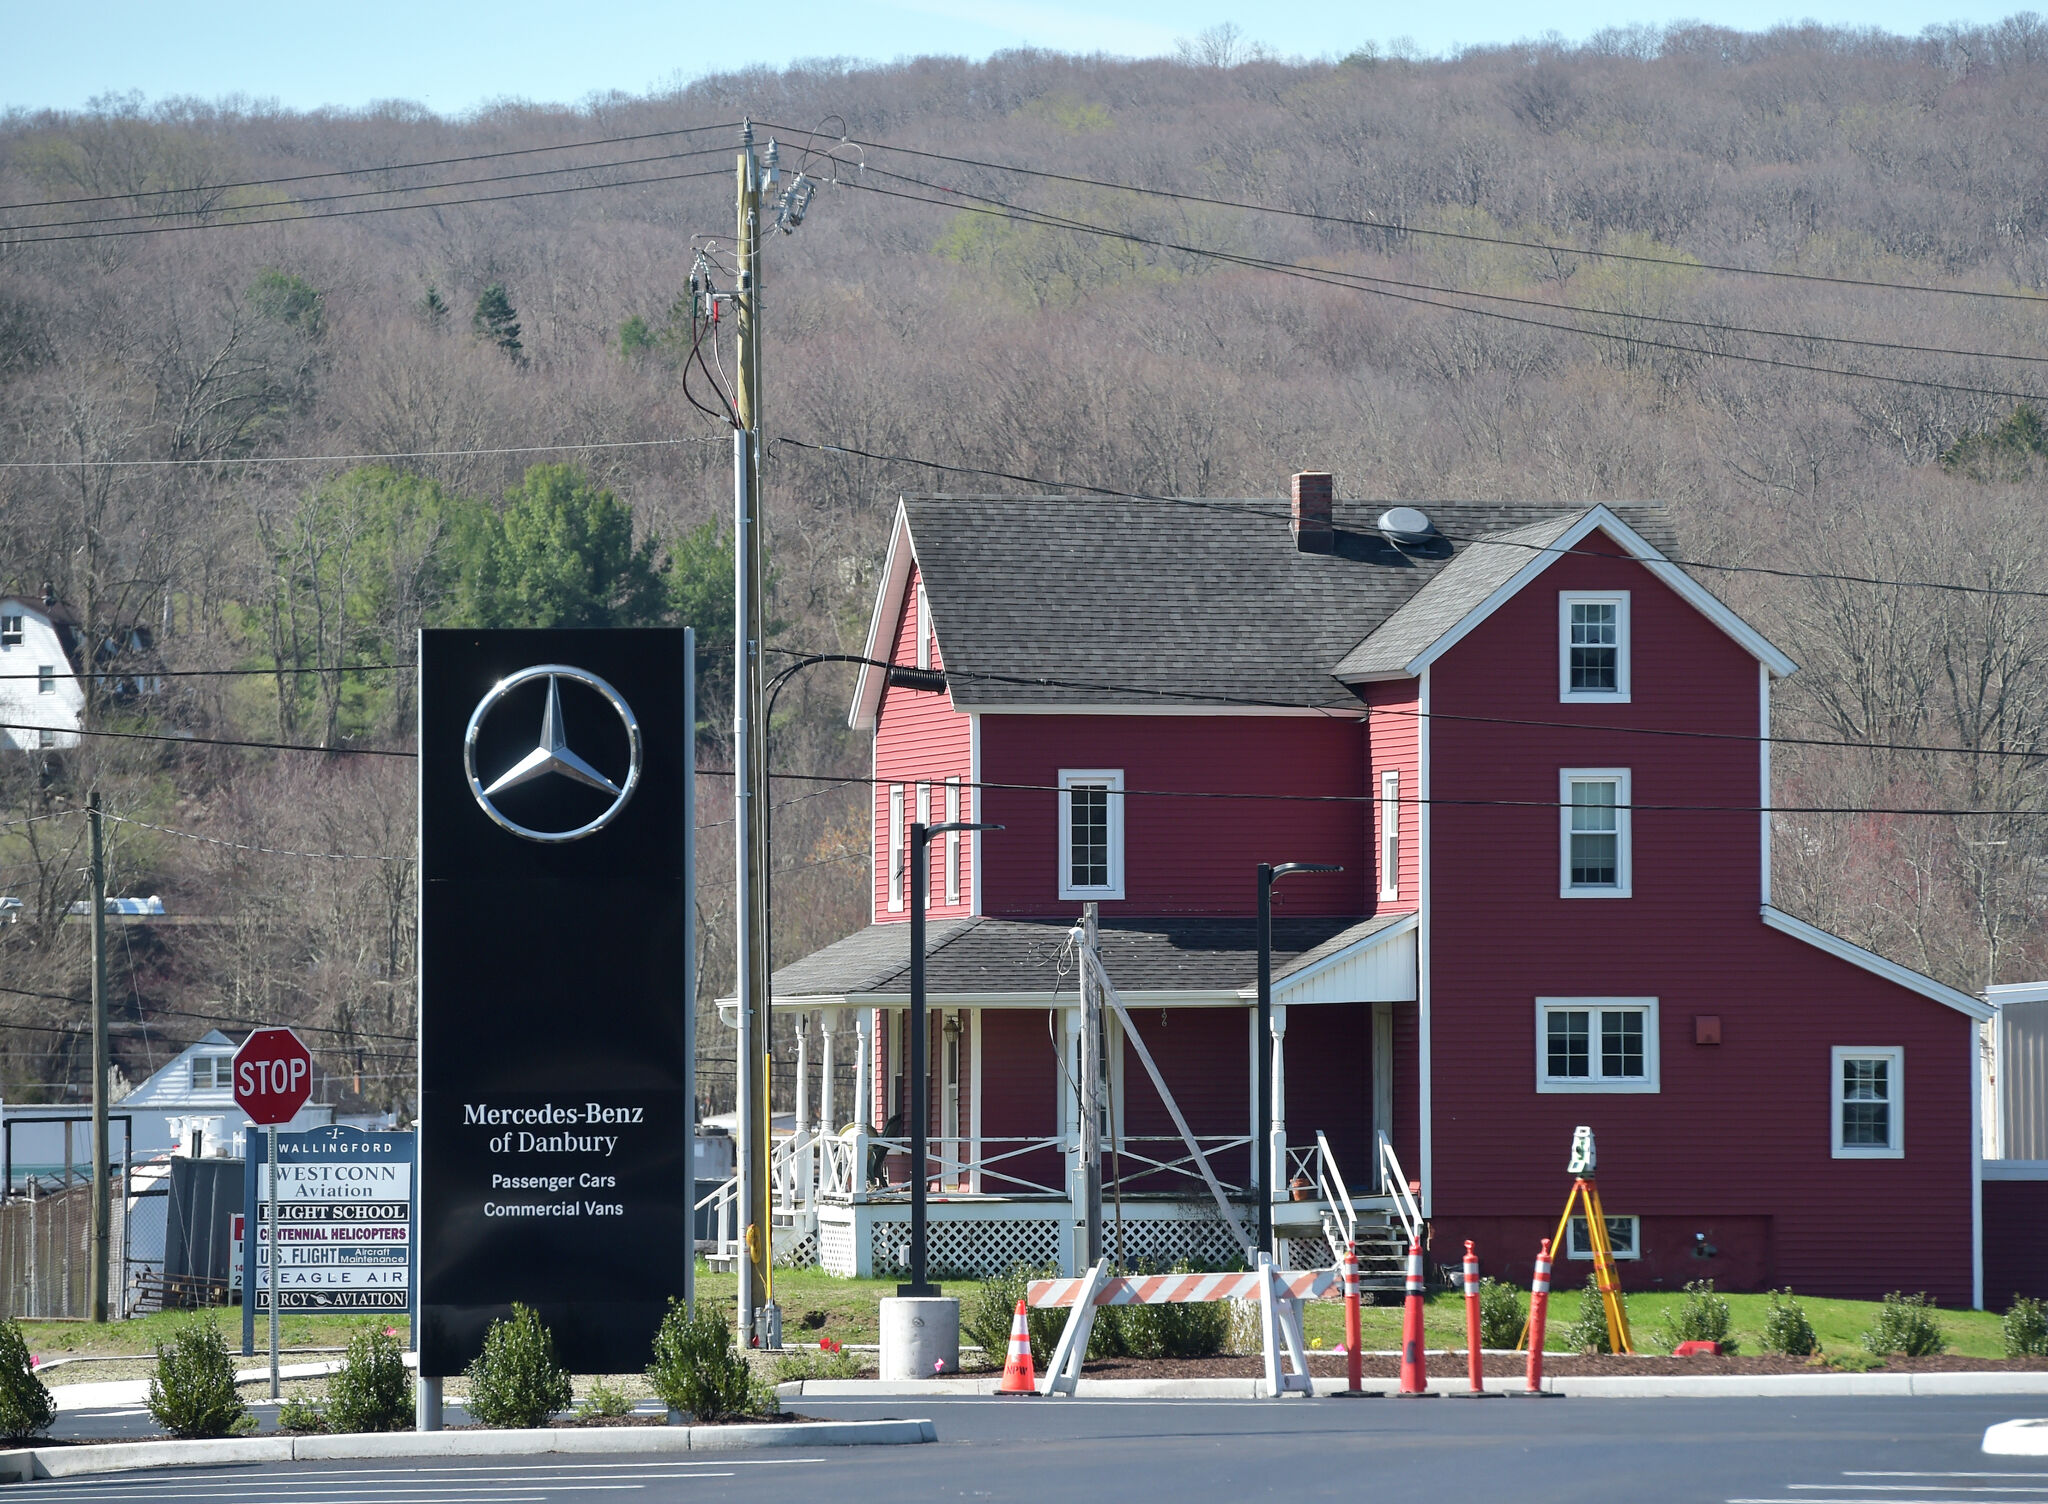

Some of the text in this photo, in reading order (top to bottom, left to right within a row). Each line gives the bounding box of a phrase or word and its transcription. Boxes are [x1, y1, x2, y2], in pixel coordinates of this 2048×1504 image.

[239, 1058, 307, 1097] STOP
[463, 1103, 644, 1125] Mercedes-Benz
[278, 1143, 392, 1153] WALLINGFORD
[489, 1131, 618, 1157] of Danbury
[492, 1173, 616, 1191] Passenger Cars
[295, 1183, 373, 1197] Aviation
[332, 1205, 405, 1219] SCHOOL
[484, 1201, 624, 1217] Commercial Vans
[260, 1228, 406, 1241] CNTENNIAL HELICOPTERS
[292, 1247, 337, 1264] FLIGHT
[340, 1255, 405, 1263] Maintenance
[354, 1248, 390, 1256] Aircraft
[280, 1272, 403, 1283] EAGLE AIR
[259, 1292, 404, 1306] DRCY AVIATION
